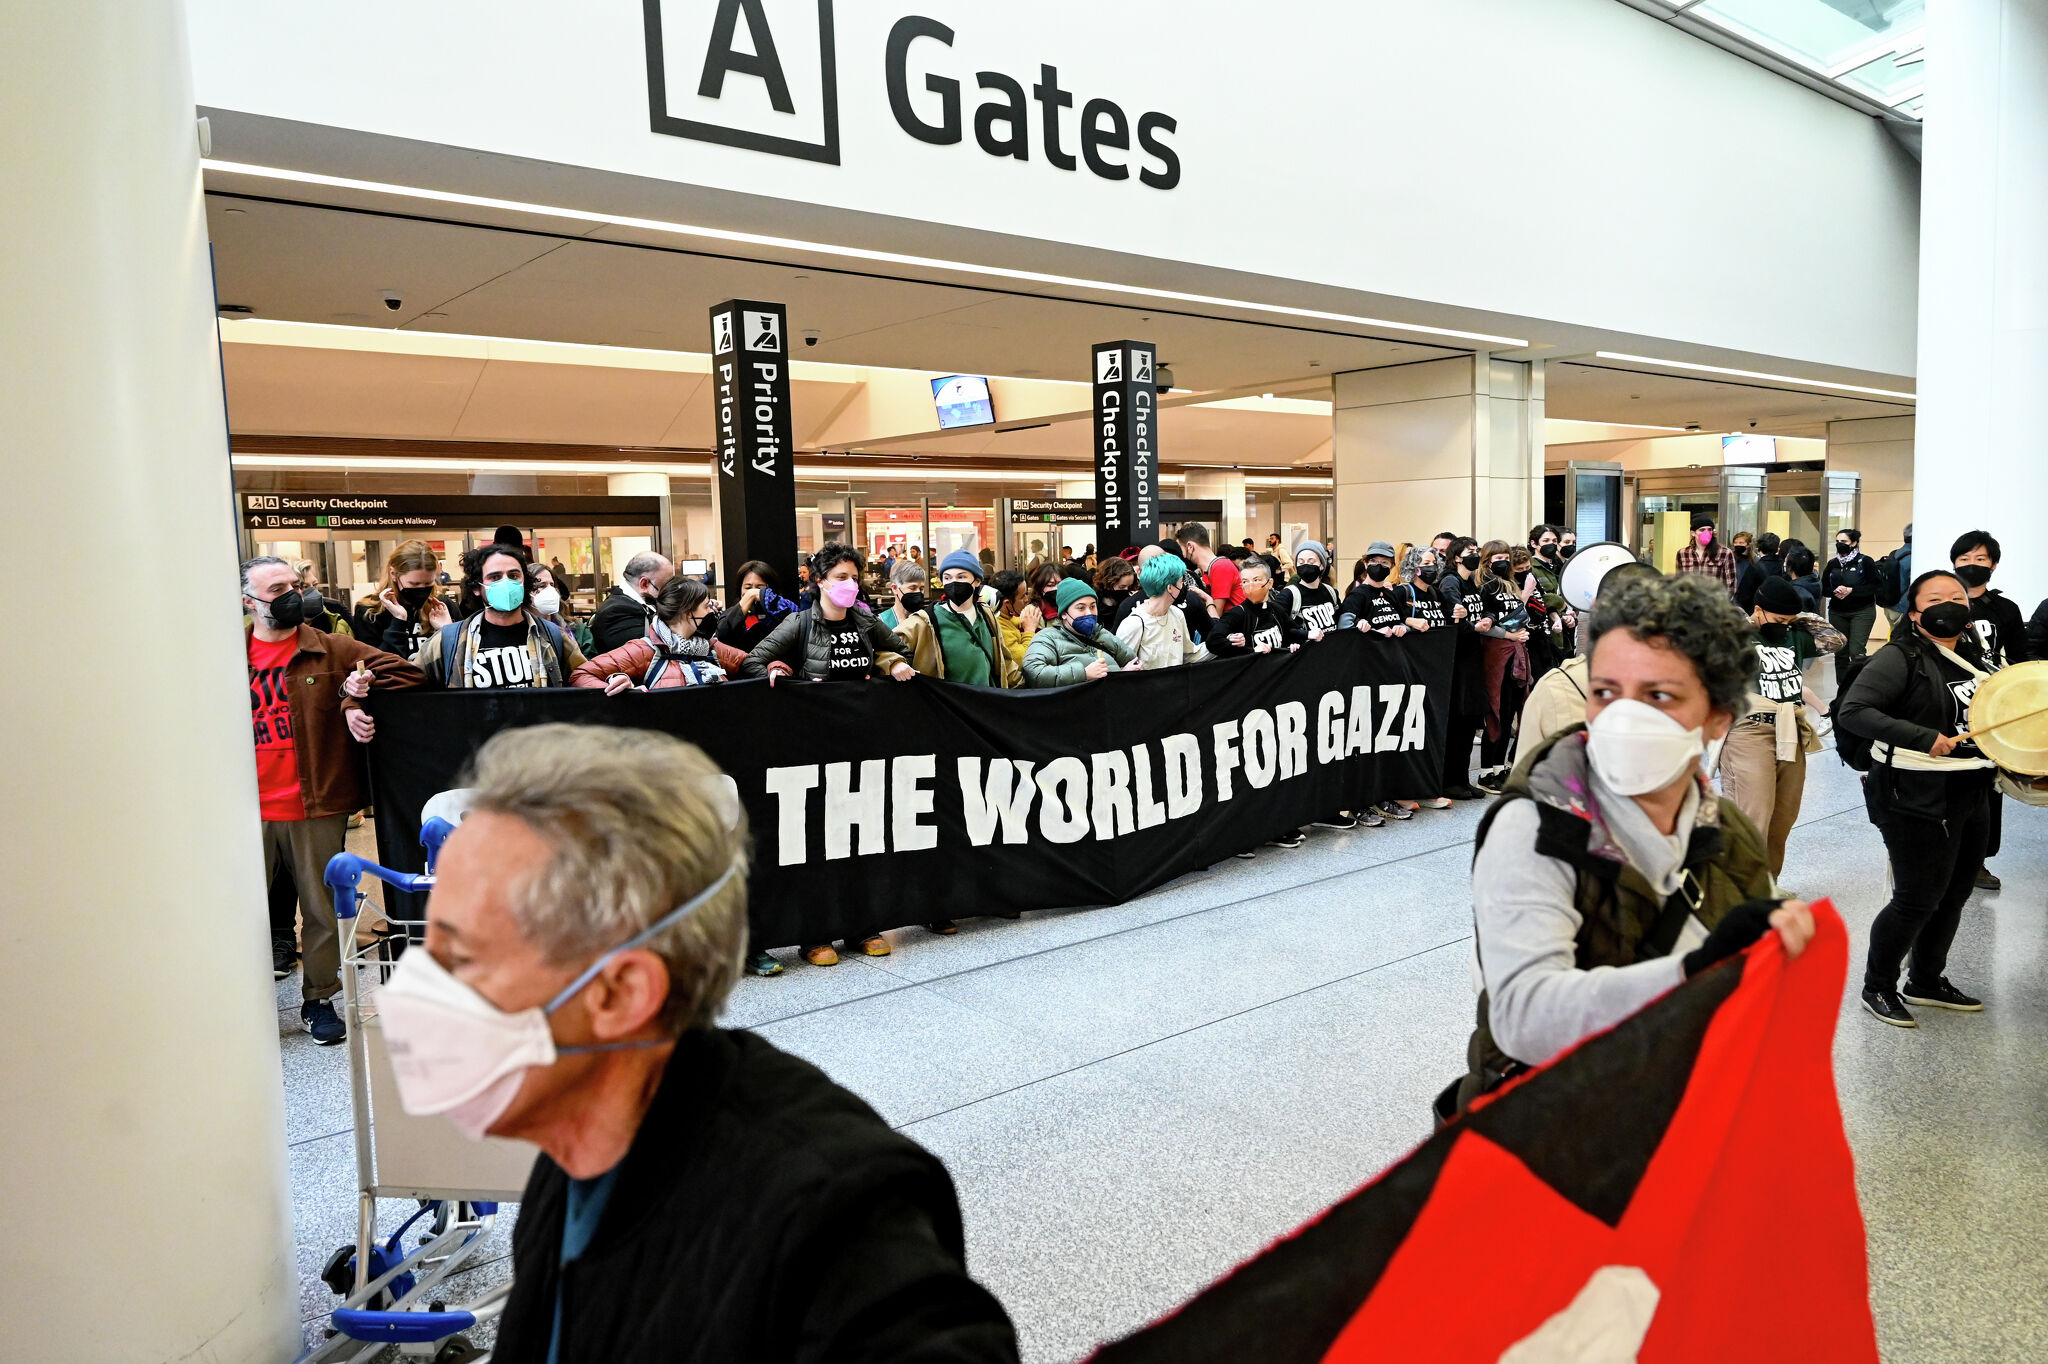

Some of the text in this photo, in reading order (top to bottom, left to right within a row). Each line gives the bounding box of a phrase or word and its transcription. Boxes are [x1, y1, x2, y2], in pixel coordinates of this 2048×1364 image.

[697, 0, 1181, 191] A Gates
[719, 363, 736, 477] Priority
[752, 362, 780, 477] Priority
[1101, 390, 1121, 529] Checkpoint
[1134, 390, 1151, 529] Checkpoint
[282, 498, 327, 510] Security
[329, 498, 388, 510] Checkpoint
[1030, 501, 1052, 510] Security
[1053, 501, 1083, 510] Checkpoint
[281, 517, 306, 526] Gates
[341, 517, 365, 526] Gates
[378, 517, 403, 526] Secure
[404, 517, 437, 526] Walkway
[1302, 601, 1336, 631] STOP
[829, 656, 870, 669] NOCID
[834, 647, 852, 656] FOR
[766, 683, 1427, 866] THE WORLD FOR GAZA
